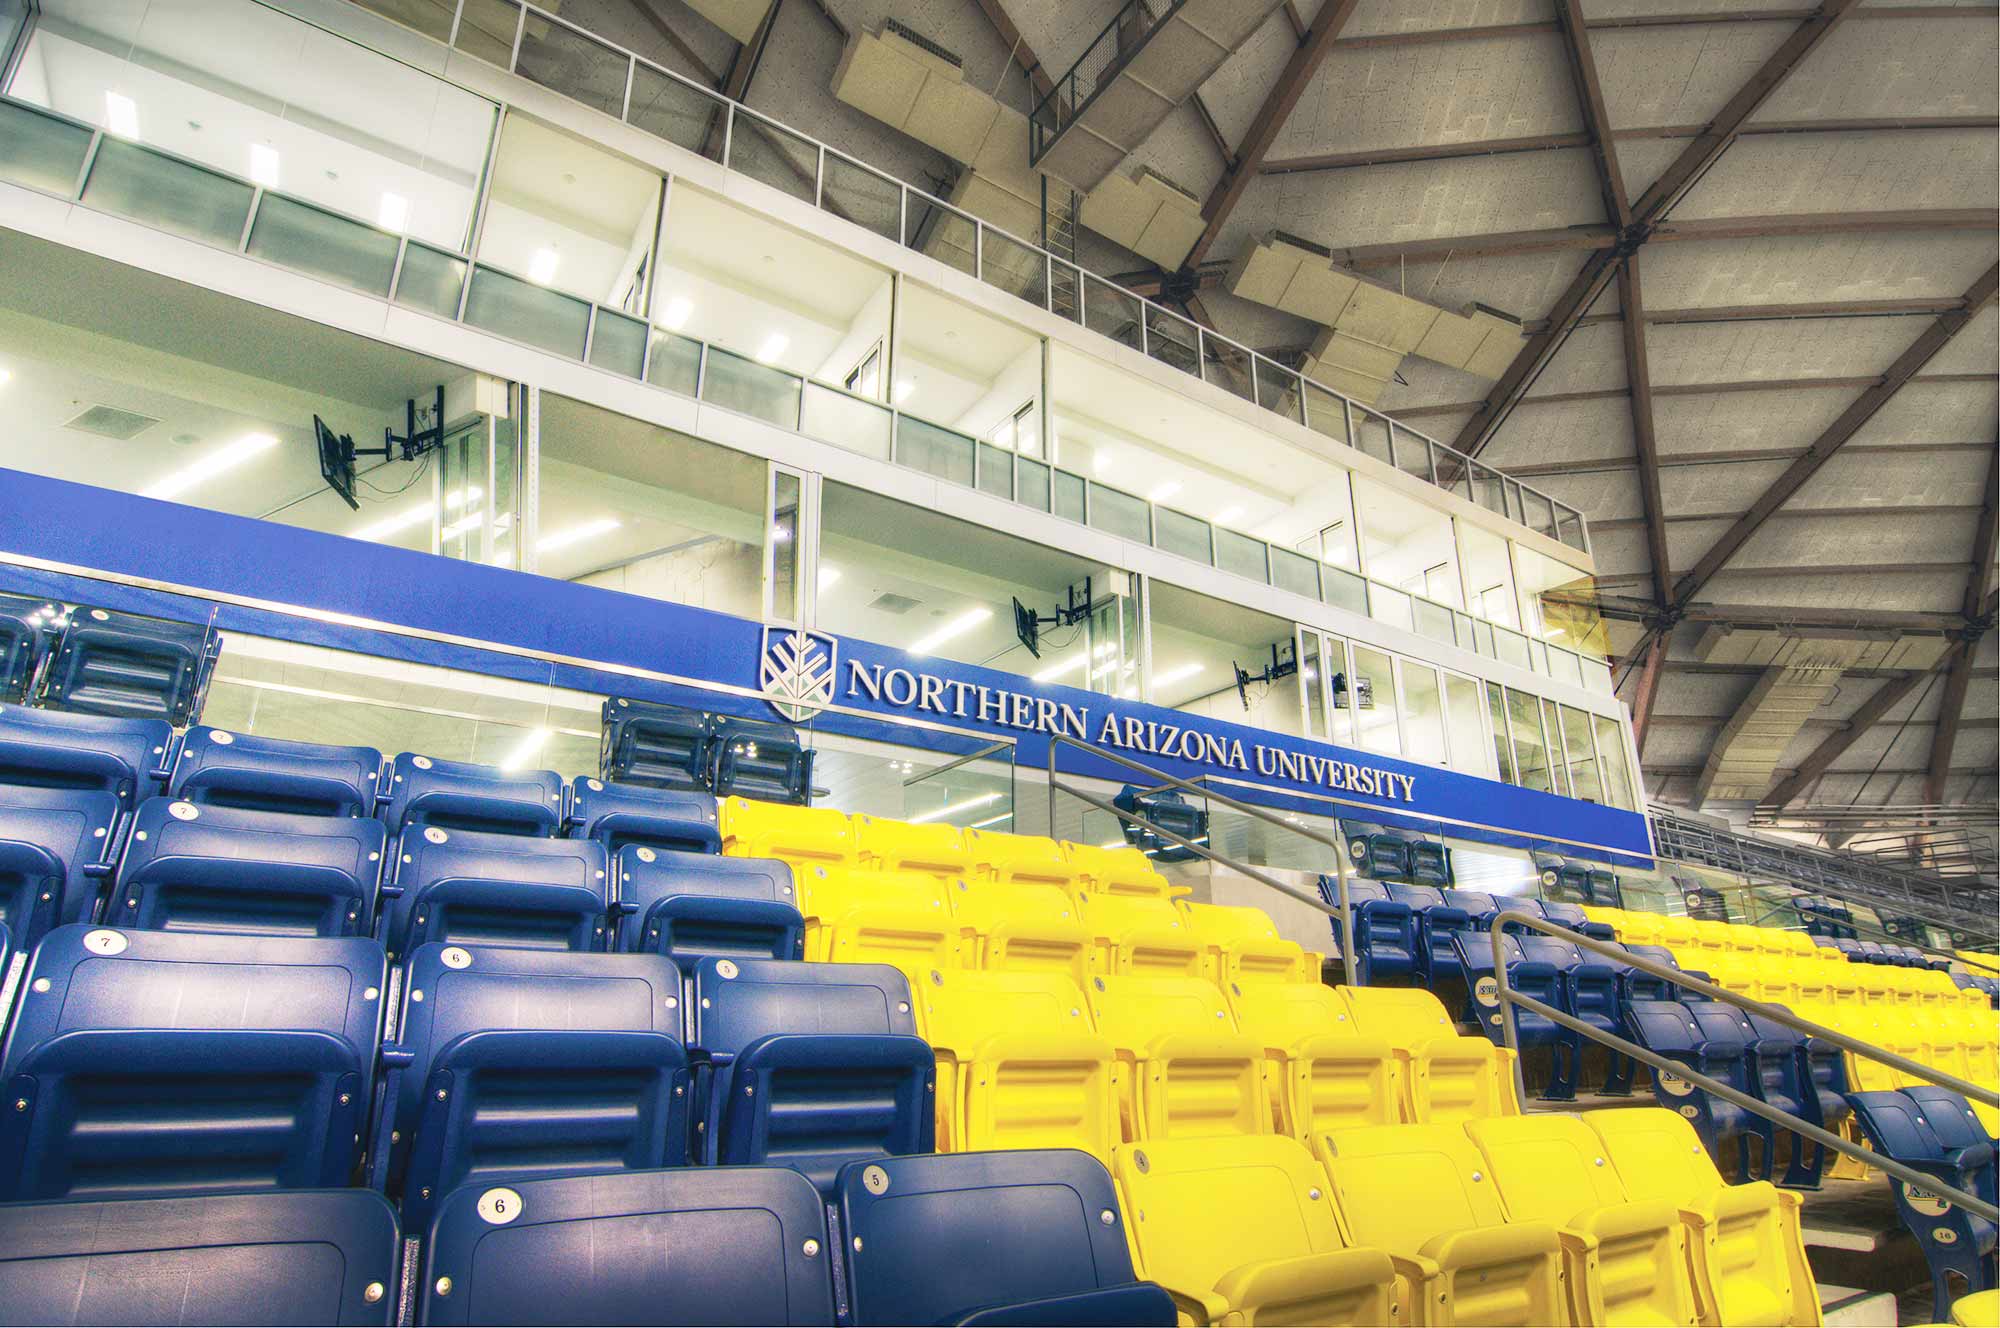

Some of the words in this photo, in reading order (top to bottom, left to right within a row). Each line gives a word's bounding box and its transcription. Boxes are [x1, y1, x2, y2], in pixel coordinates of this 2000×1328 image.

[847, 659, 1089, 740] NORTHERN
[1097, 712, 1250, 771] ARIZONA
[1255, 744, 1416, 802] UNIVERSITY
[872, 1174, 881, 1186] 5
[495, 1199, 506, 1214] 6
[1939, 1231, 1952, 1239] 16
